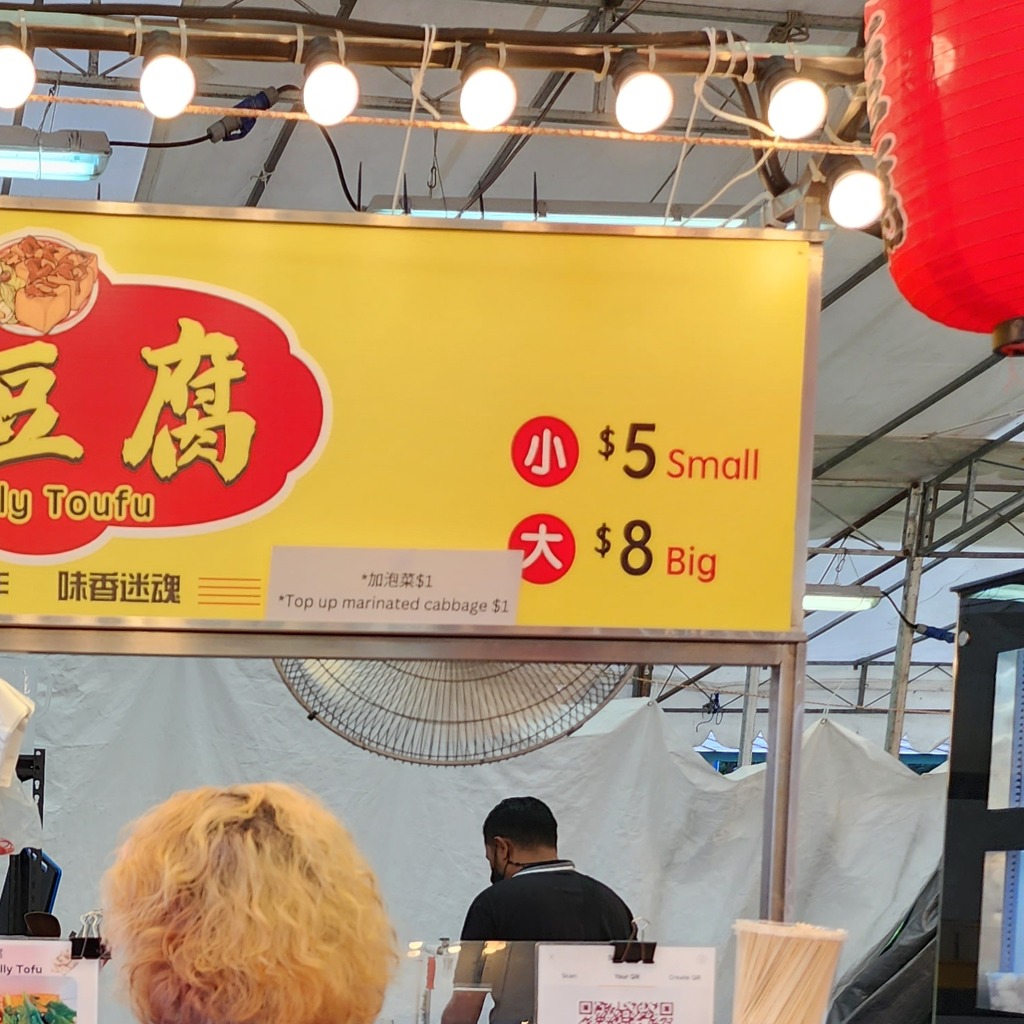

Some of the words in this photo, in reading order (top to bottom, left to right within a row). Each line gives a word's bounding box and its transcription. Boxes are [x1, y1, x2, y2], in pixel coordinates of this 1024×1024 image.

[524, 428, 567, 475] 小
[598, 423, 656, 479] $5
[666, 449, 759, 480] Small
[45, 485, 153, 520] Toufu
[520, 523, 564, 570] 大
[594, 519, 653, 576] $8
[666, 546, 717, 583] Big
[57, 570, 181, 604] 味香迷魂
[319, 598, 338, 611] up
[342, 596, 419, 611] marinated
[424, 598, 488, 615] cabbage
[492, 598, 509, 613] $1
[16, 964, 43, 974] Tofu
